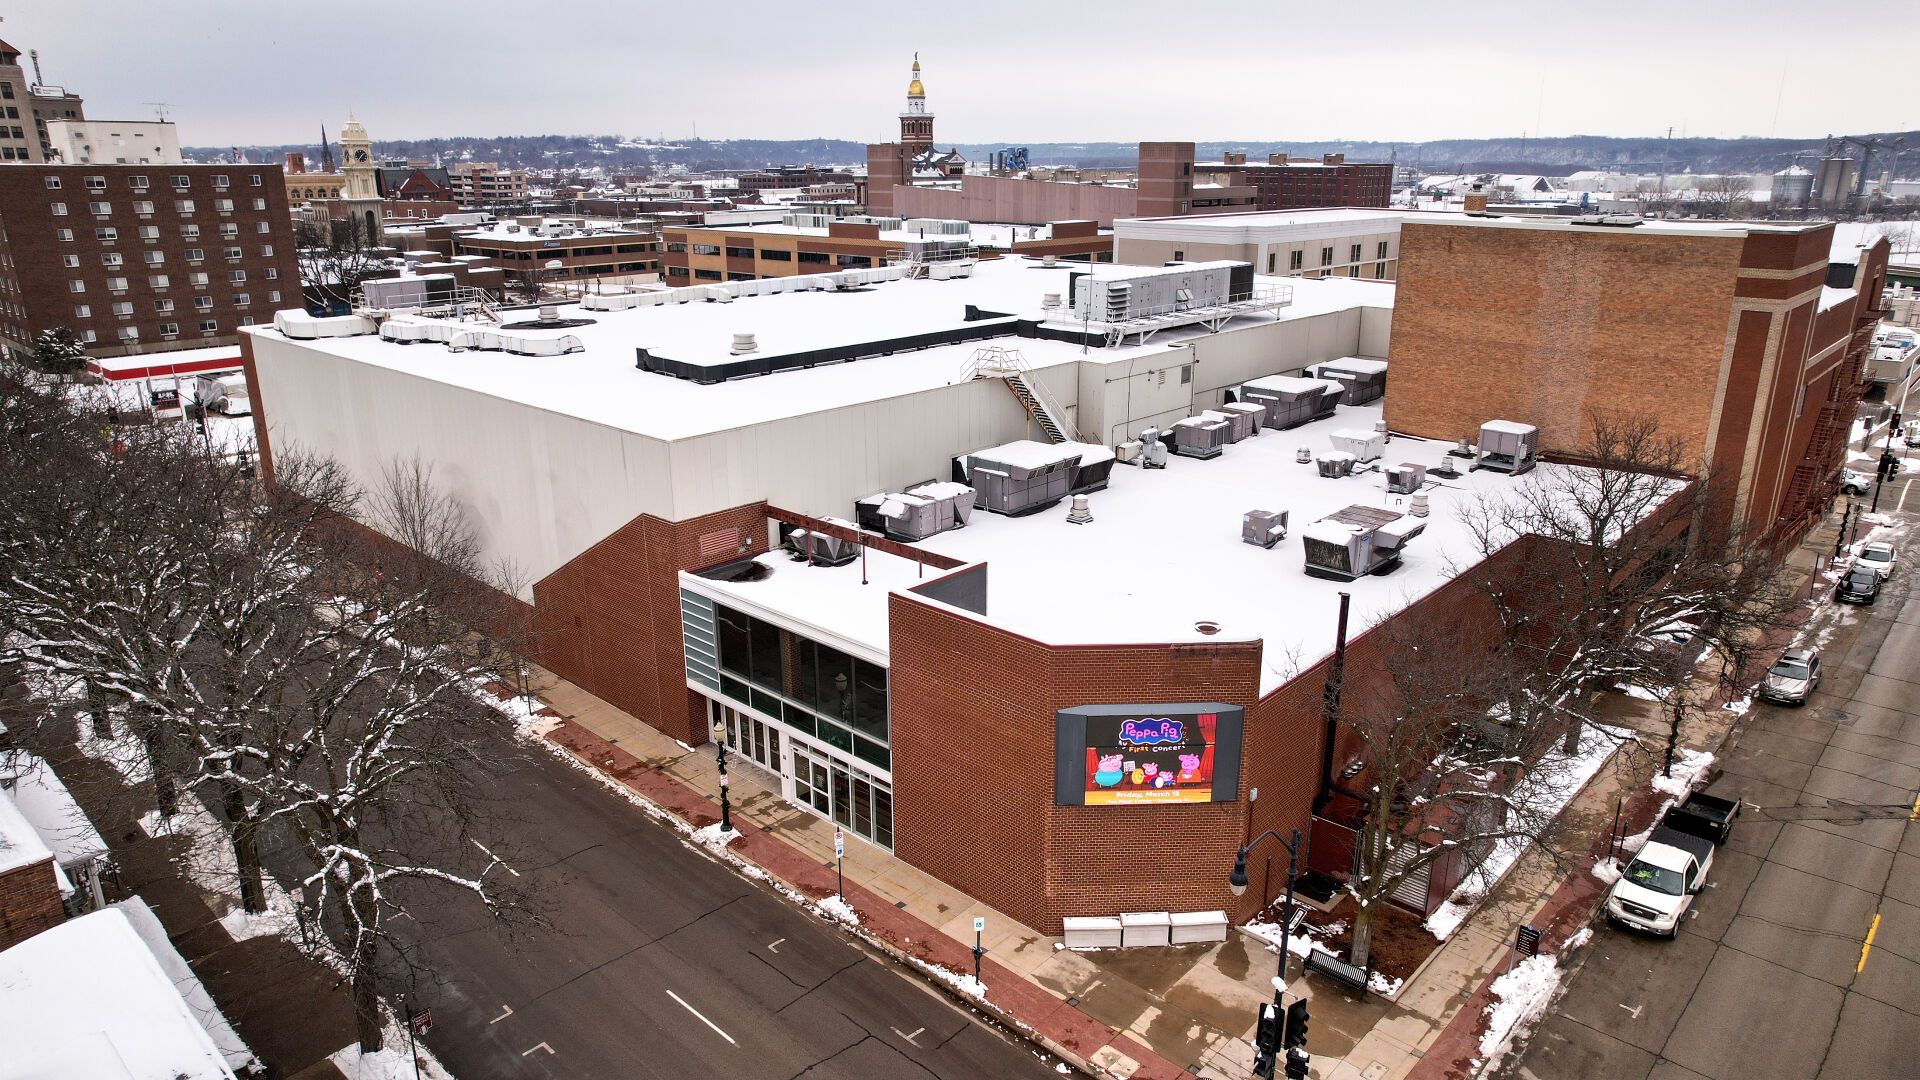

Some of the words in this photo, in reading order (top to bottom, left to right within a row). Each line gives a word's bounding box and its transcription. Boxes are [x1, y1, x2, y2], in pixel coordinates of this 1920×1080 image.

[1125, 722, 1159, 740] Peppa
[1160, 722, 1178, 739] Pig
[1128, 744, 1149, 753] First
[1152, 741, 1186, 753] Concert
